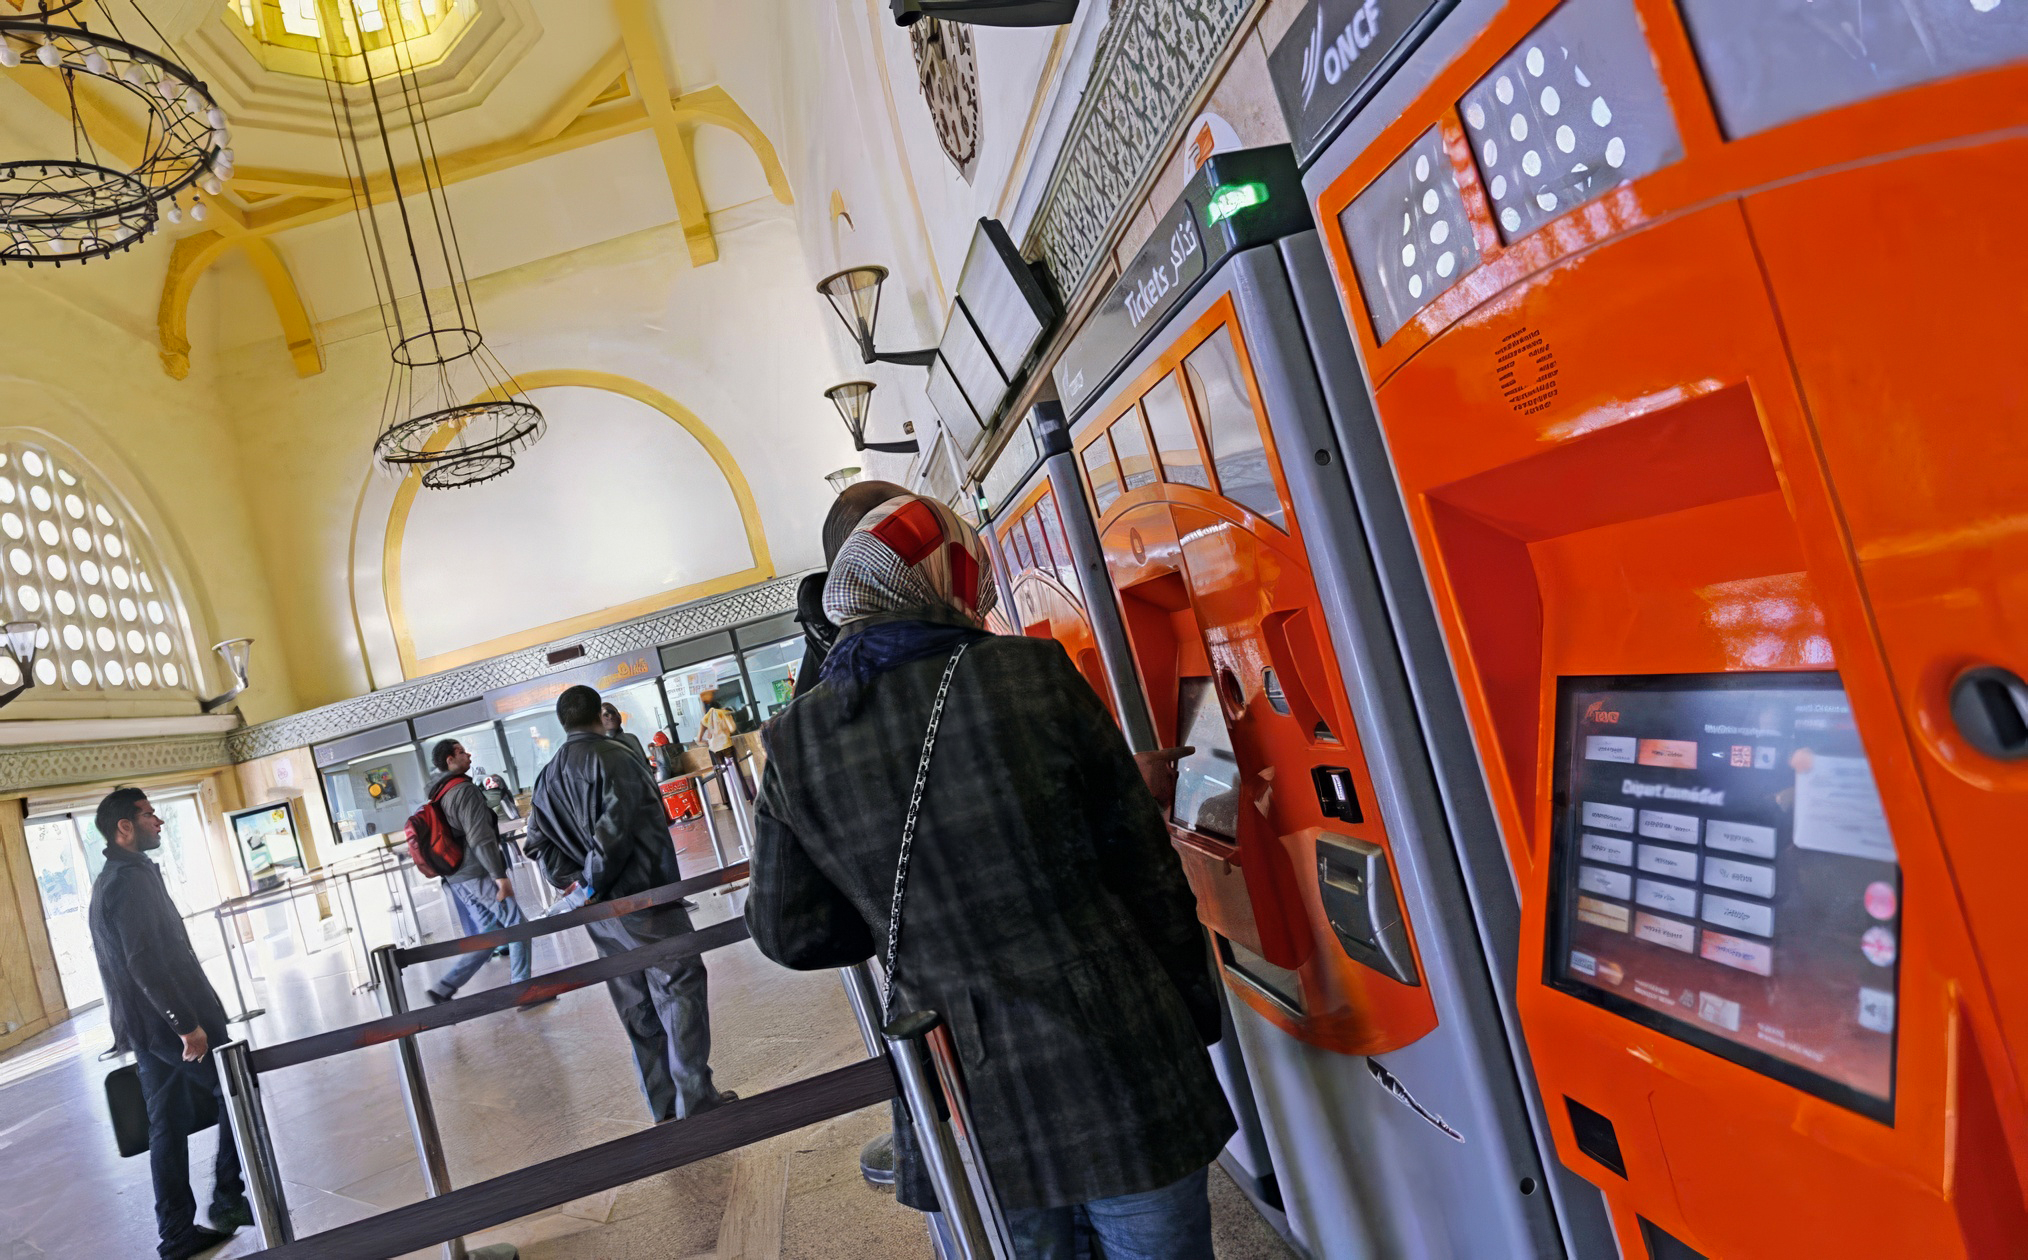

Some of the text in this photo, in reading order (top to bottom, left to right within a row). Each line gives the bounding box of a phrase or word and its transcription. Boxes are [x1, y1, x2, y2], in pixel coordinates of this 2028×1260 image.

[1323, 0, 1379, 85] ONCF
[1170, 220, 1197, 288] تذاكر
[1124, 265, 1170, 328] Tickets
